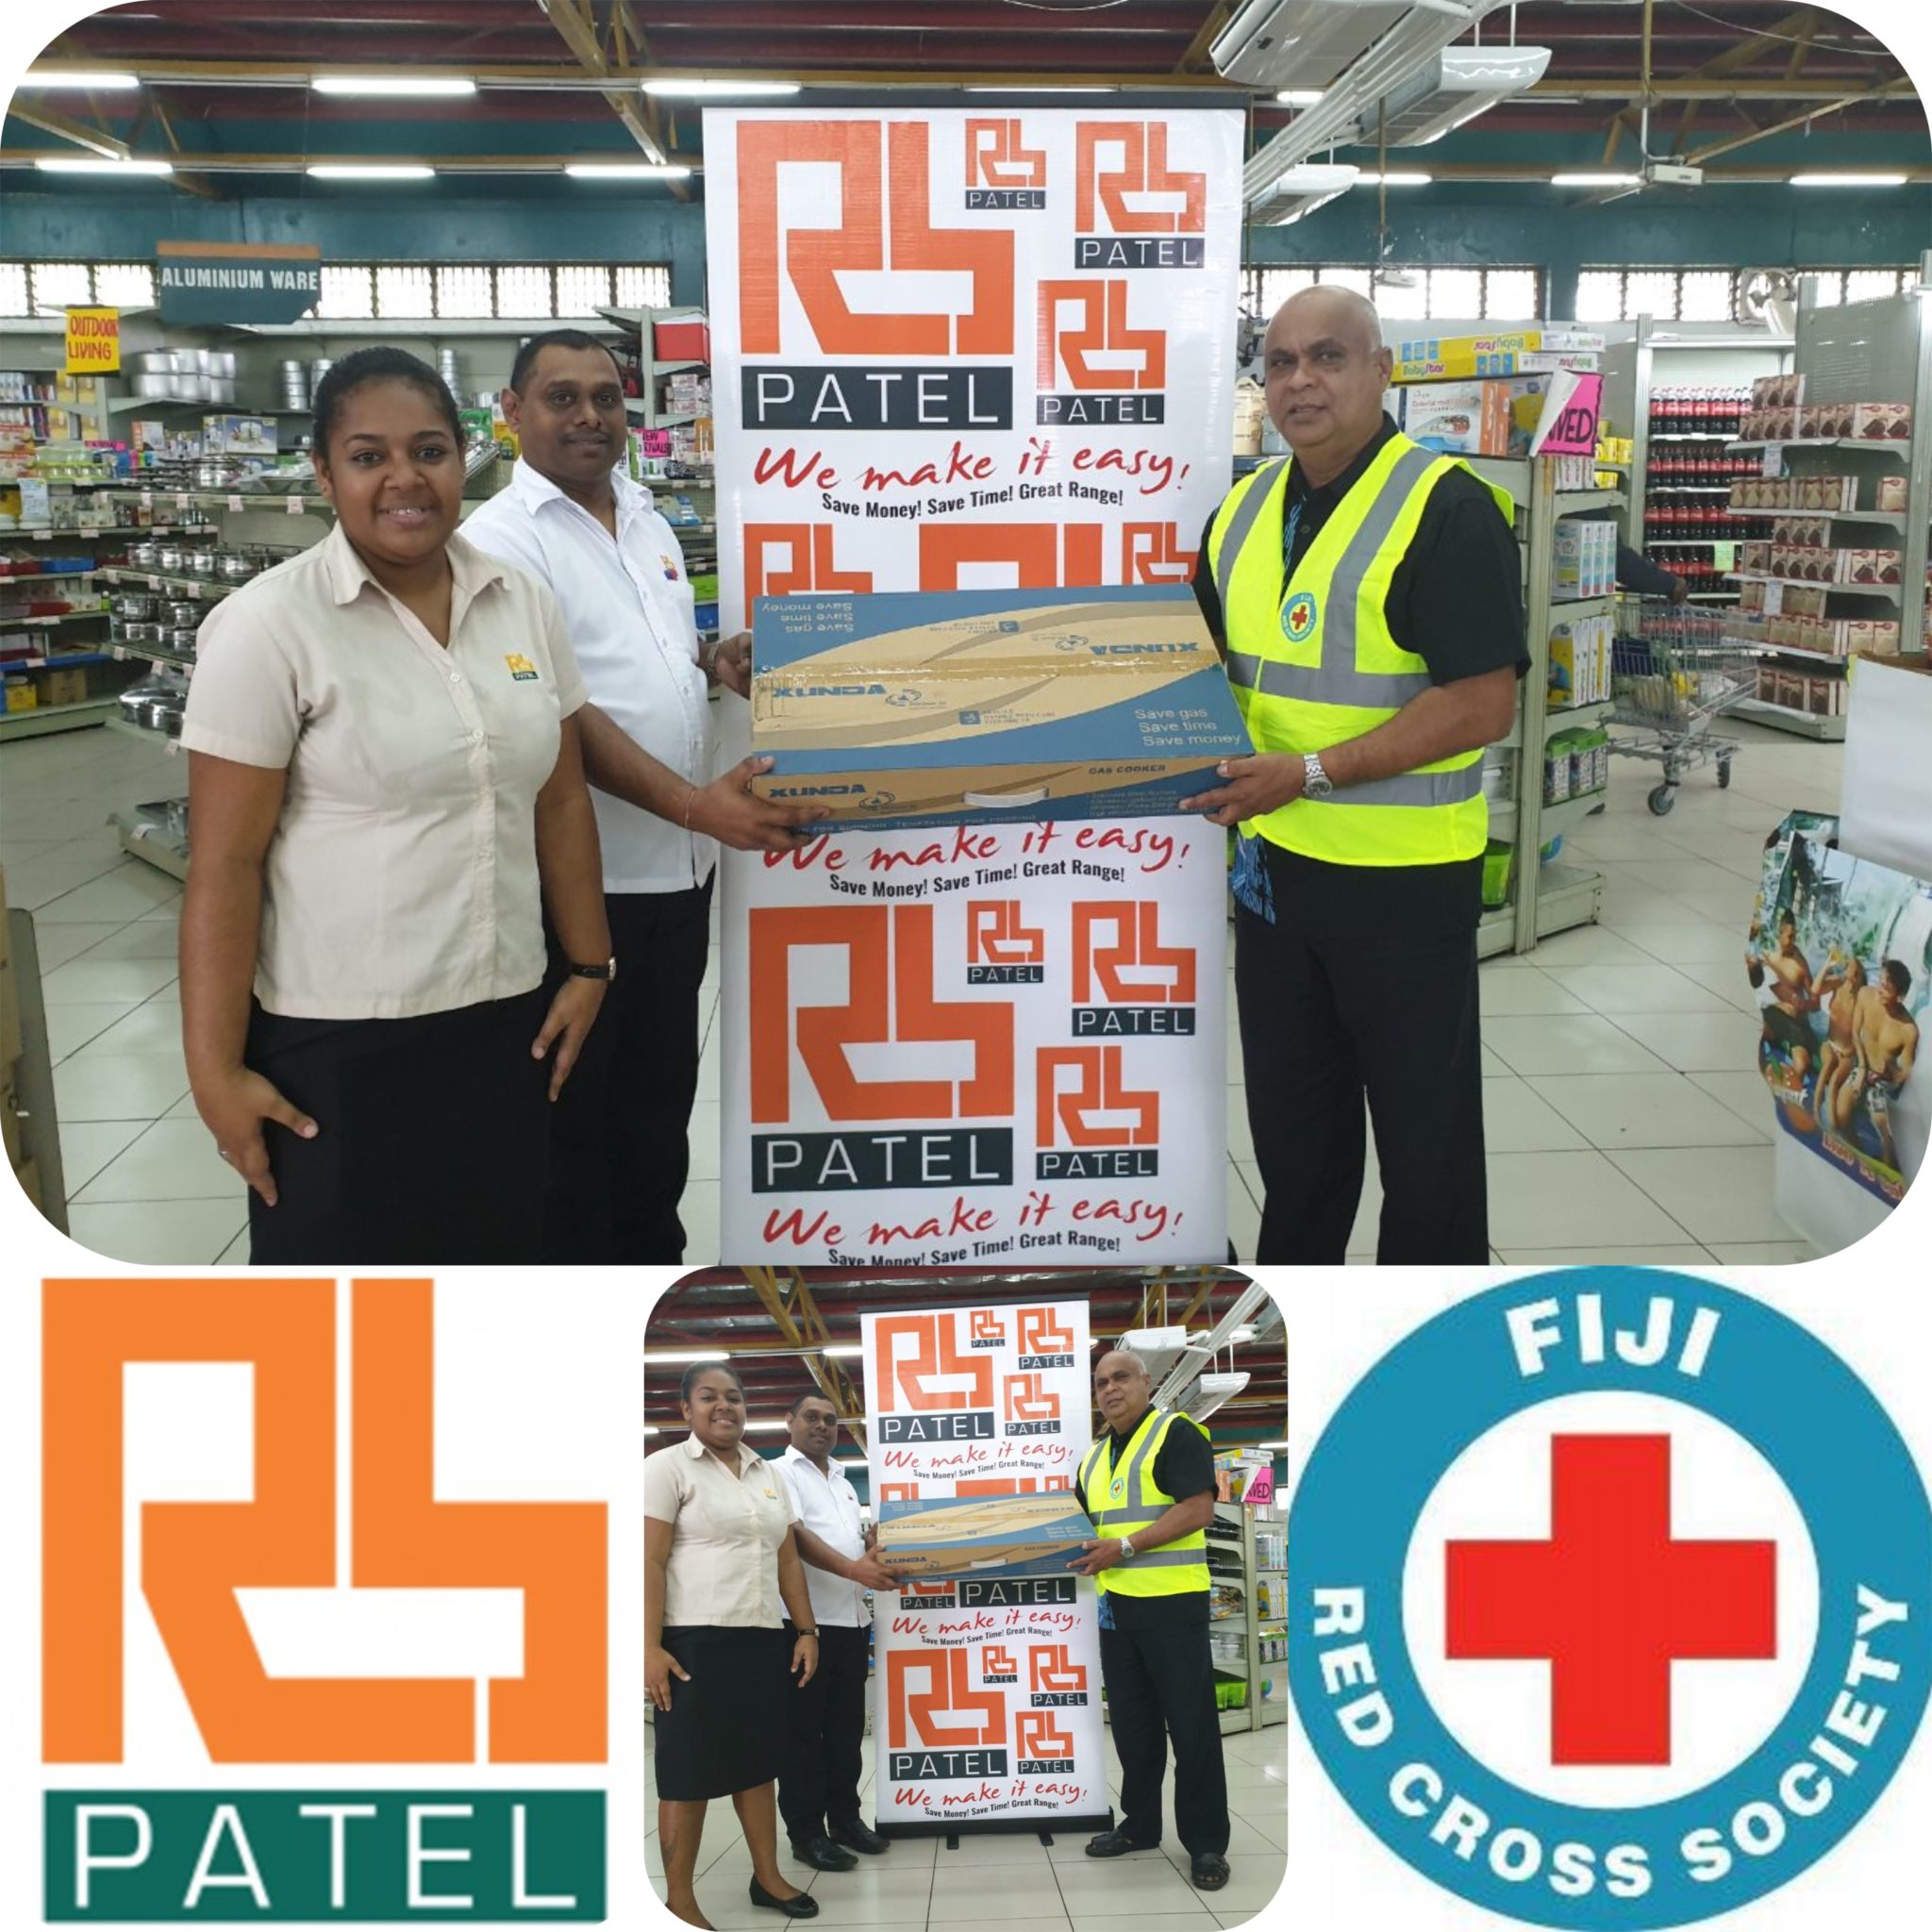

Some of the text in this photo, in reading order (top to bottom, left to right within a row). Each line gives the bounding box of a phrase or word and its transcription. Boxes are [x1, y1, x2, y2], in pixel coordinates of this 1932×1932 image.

[969, 192, 1041, 208] PATEL
[1081, 240, 1198, 267] PATEL
[162, 268, 318, 291] ALUMINIUM WARE
[68, 341, 111, 360] LIVING
[758, 374, 998, 423] PATEL
[1043, 398, 1158, 424] PATEL
[755, 437, 1191, 495] We make it easy!
[823, 482, 1124, 520] Save Money! Save Time! Great Range!
[816, 602, 852, 611] Save
[816, 613, 853, 623] Save
[786, 624, 854, 633] Save gas
[773, 684, 887, 698] XUNDA
[1135, 709, 1208, 722] Save gas
[1140, 721, 1217, 733] Save time
[1143, 734, 1241, 746] Save money
[769, 784, 867, 798] XUNDA
[870, 824, 1001, 873] make
[1024, 822, 1056, 854] it
[1076, 826, 1190, 872] easy!
[830, 860, 1125, 898] Save Money! Save Time! Great Range!
[971, 967, 1041, 983] PATEL
[1079, 1009, 1189, 1034] PATEL
[767, 1136, 1000, 1185] PATEL
[1042, 1152, 1152, 1176] PATEL
[763, 1191, 1184, 1246] We make it easy!
[828, 1249, 865, 1265] Save
[931, 1250, 967, 1264] Save
[973, 1236, 1014, 1257] Time!
[1020, 1232, 1062, 1250] Great
[1068, 1230, 1121, 1252] Range!
[972, 1339, 1005, 1348] PATEL
[1021, 1355, 1073, 1368] PATEL
[885, 1415, 989, 1441] PATEL
[1008, 1422, 1058, 1435] PATEL
[885, 1441, 1074, 1469] We make it easy!
[913, 1459, 1044, 1479] Save Money! Save Time! Great Range!
[965, 1578, 1072, 1605] PATEL
[903, 1597, 953, 1608] PATEL
[892, 1608, 1082, 1635] We make it easy!
[921, 1627, 1053, 1646] Save Money! Save Time! Great Range!
[1033, 1693, 1085, 1706] PATEL
[896, 1753, 1001, 1777] PATEL
[1020, 1761, 1072, 1773] PATEL
[895, 1779, 1087, 1806] We make it easy!
[924, 1798, 1058, 1818] Save Money! Save Time! Great Range!
